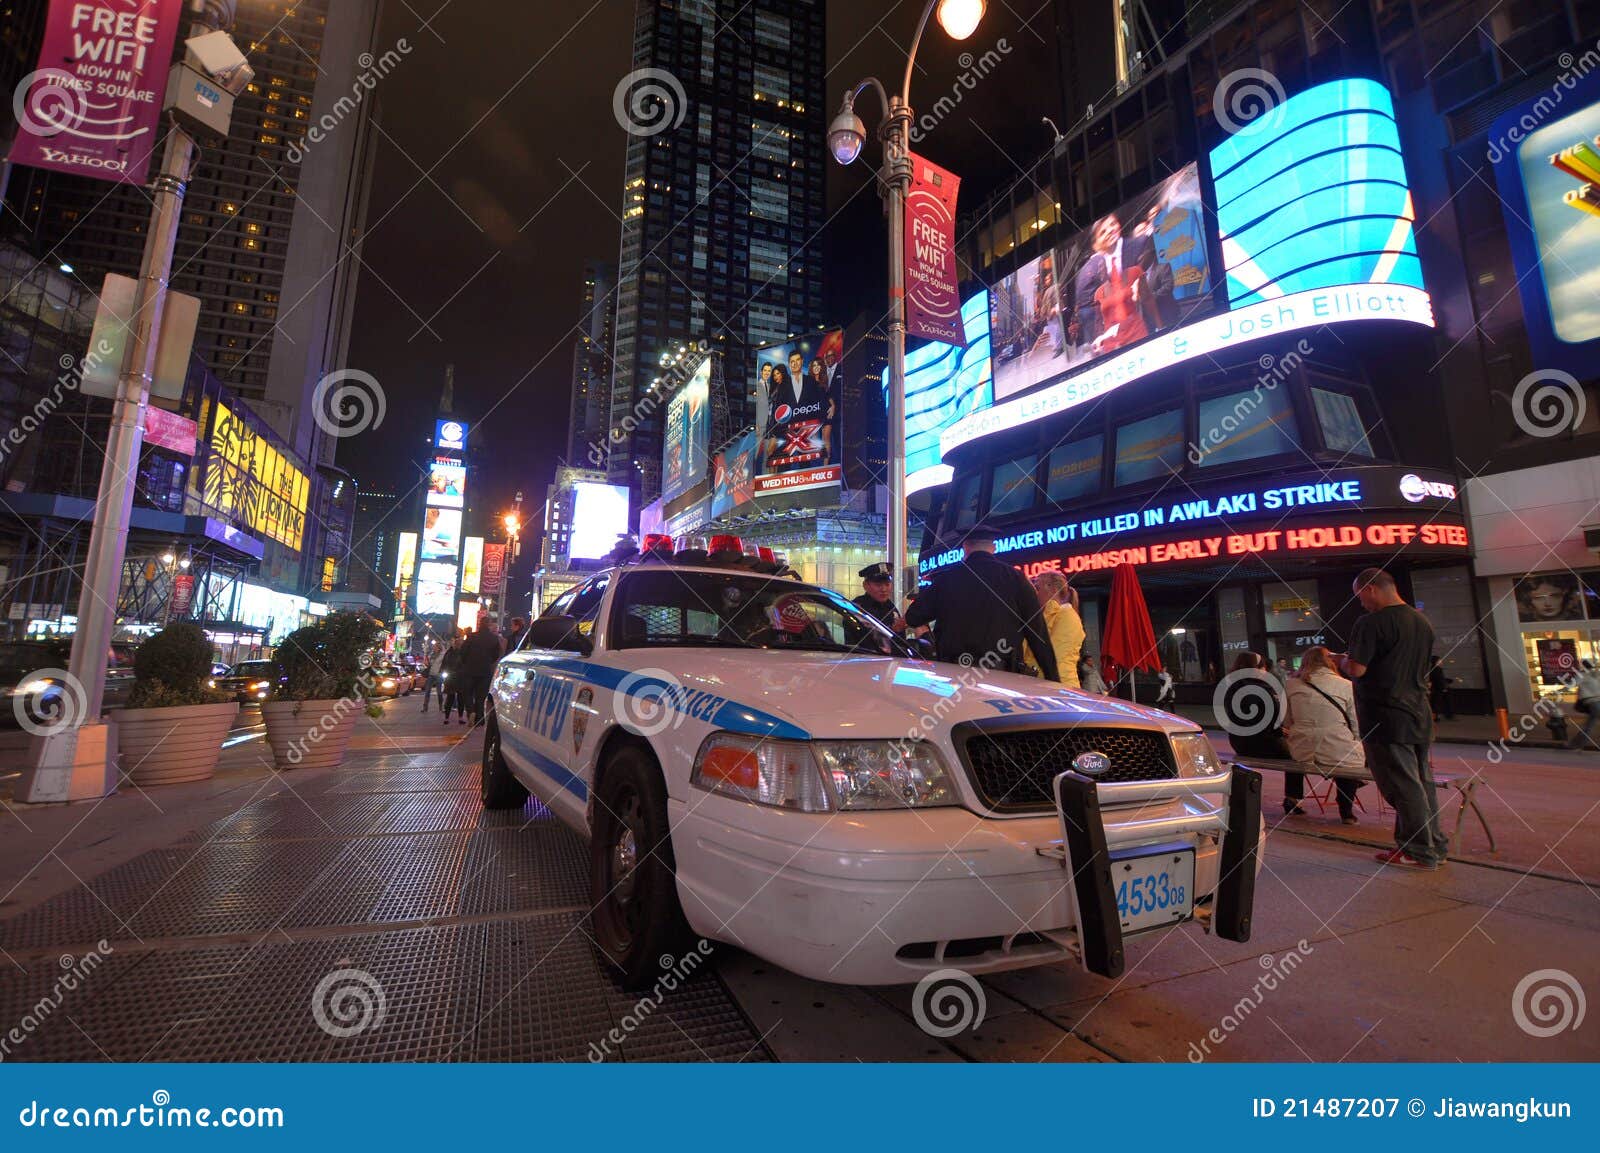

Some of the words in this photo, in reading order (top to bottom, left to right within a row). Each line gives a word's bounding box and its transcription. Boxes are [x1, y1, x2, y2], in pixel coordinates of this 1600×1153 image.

[71, 4, 158, 43] FREE
[73, 33, 146, 70] WIFI
[46, 73, 93, 92] TIMES
[96, 83, 155, 103] SQUARE
[77, 64, 113, 80] NOW
[116, 71, 131, 82] IN
[194, 81, 220, 104] NYPD
[39, 147, 128, 173] YAHOO!
[1548, 142, 1585, 165] THE
[1563, 182, 1592, 204] OF
[913, 218, 947, 251] FREE
[915, 240, 945, 270] WIFI
[909, 268, 930, 284] TIMES
[930, 276, 955, 294] SQUARE
[919, 262, 934, 276] NOW
[936, 269, 943, 279] IN
[1020, 398, 1059, 418] Lara
[1066, 356, 1147, 402] Spencer
[1219, 305, 1296, 341] Josh
[1313, 291, 1408, 318] Elliott
[792, 402, 820, 417] pepsi
[782, 423, 824, 456] X
[811, 471, 826, 481] FOX
[826, 470, 833, 479] 5
[260, 483, 282, 521] LION
[281, 500, 302, 534] KING
[1047, 524, 1077, 545] NOT
[1081, 512, 1139, 538] KILLED
[1143, 508, 1163, 527] IN
[1169, 493, 1257, 523] AWLAKI
[1263, 480, 1361, 509] STRIKE
[1024, 559, 1062, 579] LOSE
[1064, 547, 1147, 574] JOHNSON
[1150, 537, 1222, 563] EARLY
[1227, 530, 1282, 555] BUT
[1287, 526, 1362, 550] HOLD
[1366, 524, 1417, 546] OFF
[524, 673, 574, 742] NYPD
[667, 683, 724, 723] POLICE
[1082, 754, 1104, 769] Ford
[1114, 872, 1169, 918] 4533
[1170, 885, 1185, 907] 08
